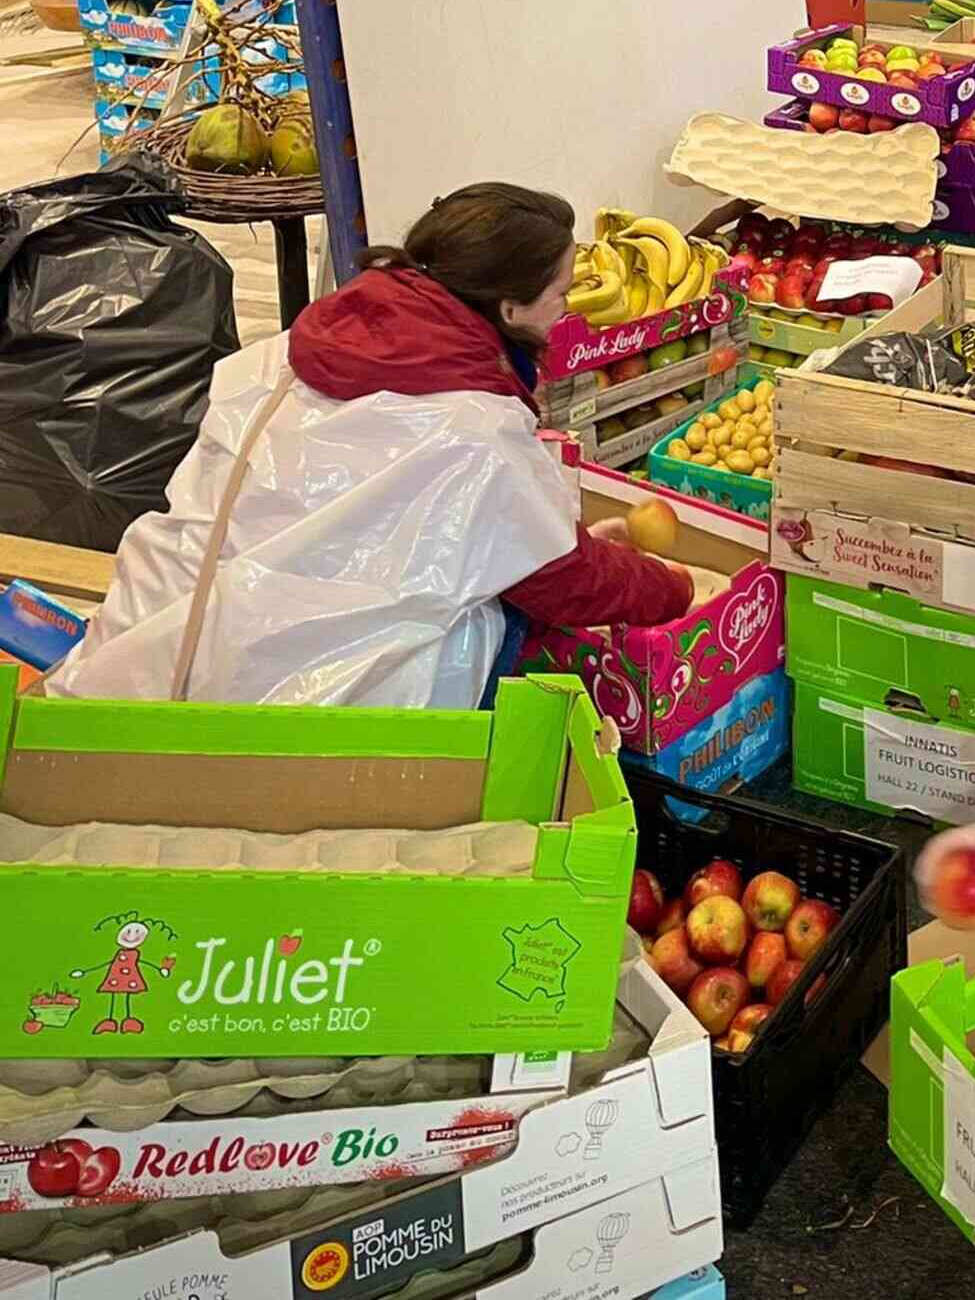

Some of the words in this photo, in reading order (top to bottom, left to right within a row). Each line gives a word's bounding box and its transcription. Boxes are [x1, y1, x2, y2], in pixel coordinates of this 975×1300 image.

[566, 334, 609, 370] Pink
[608, 326, 646, 356] Lady
[832, 546, 868, 570] Sweet
[870, 555, 936, 583] Sensation
[834, 527, 902, 558] Succombez
[905, 547, 918, 563] à
[919, 548, 935, 565] la
[729, 583, 768, 640] Pink
[680, 698, 776, 783] PHILIBON
[904, 735, 958, 759] INNATIS
[878, 749, 915, 770] FRUIT
[878, 773, 903, 790] HALL
[906, 780, 919, 793] 22
[929, 785, 966, 806] STAND
[168, 1013, 223, 1034] c'est
[272, 1013, 323, 1033] c'est
[326, 1007, 372, 1033] BIO
[331, 1127, 399, 1168] Bio
[353, 1218, 427, 1262] POMME
[430, 1213, 453, 1233] DU
[355, 1221, 383, 1240] AOP
[353, 1227, 454, 1281] LIMOUSIN
[181, 1273, 229, 1291] POMME
